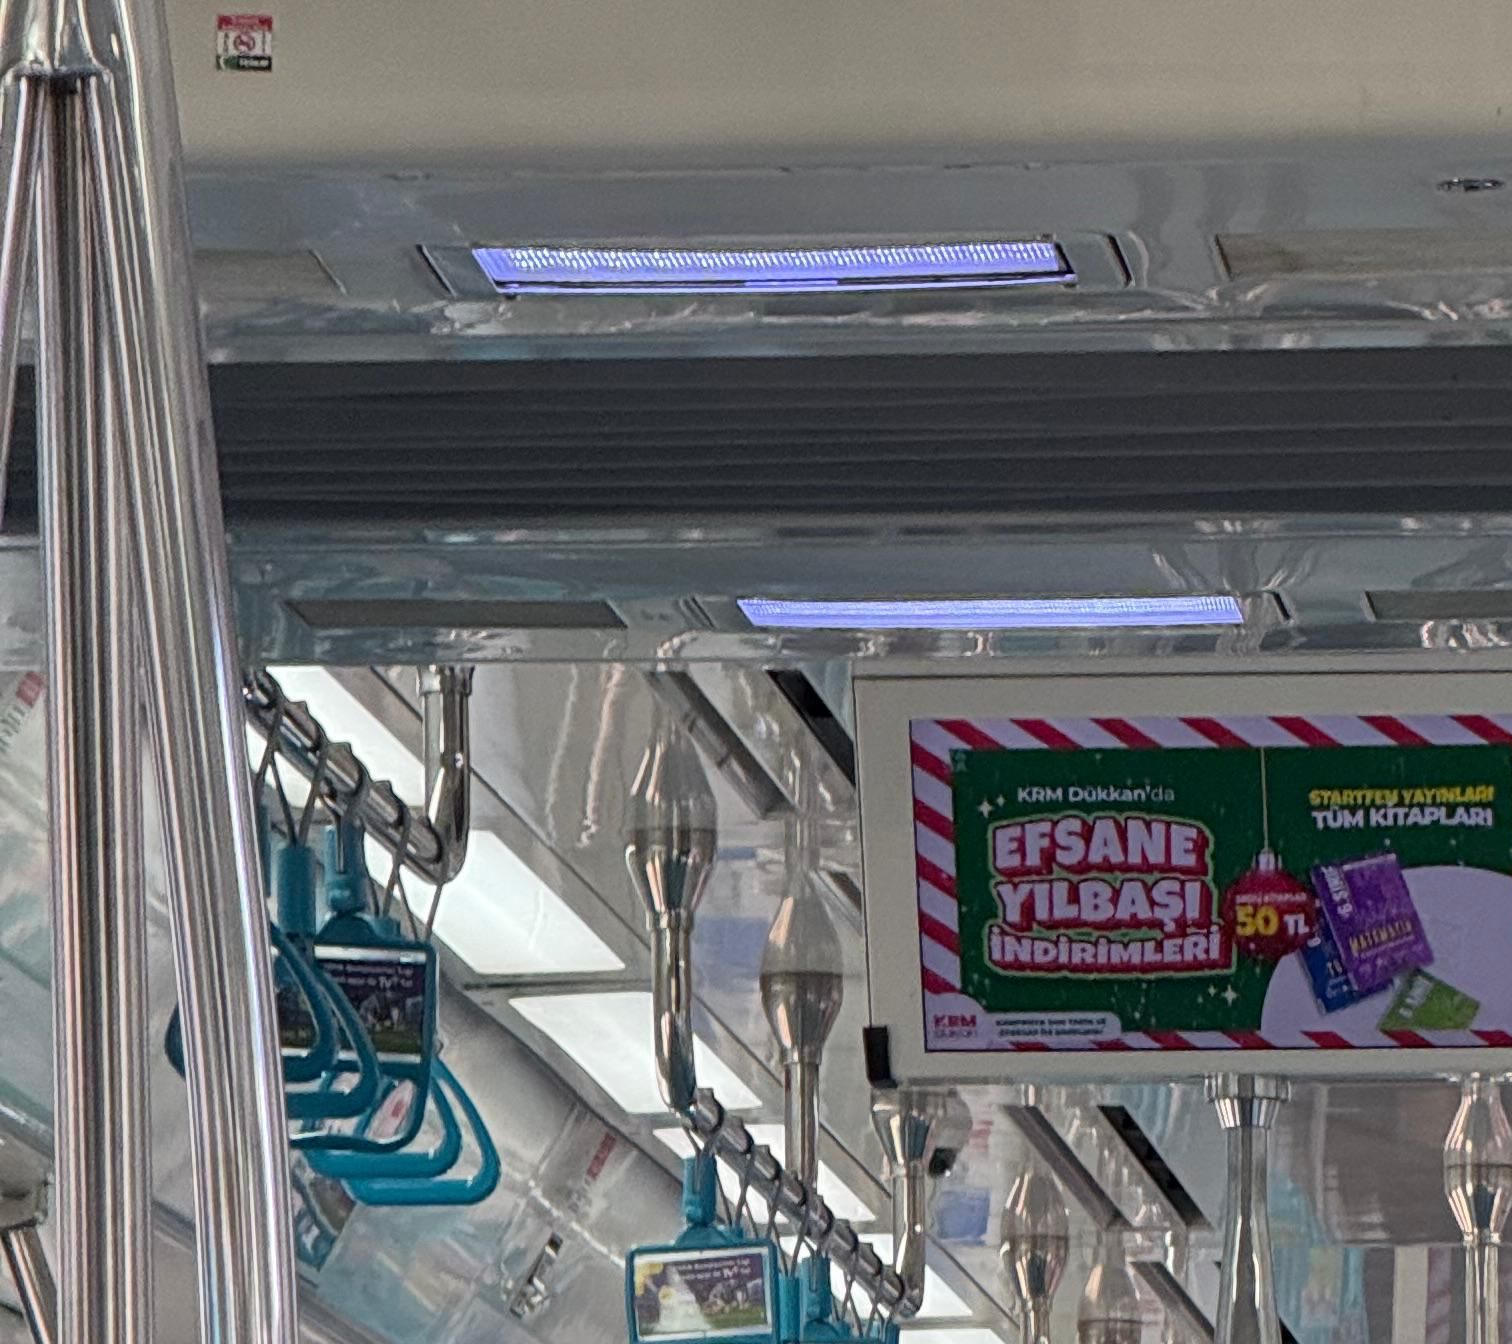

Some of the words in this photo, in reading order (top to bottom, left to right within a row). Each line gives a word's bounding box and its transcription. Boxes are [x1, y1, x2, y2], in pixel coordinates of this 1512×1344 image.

[1017, 786, 1063, 803] KRM
[1068, 784, 1175, 803] Dükkan'da
[1312, 807, 1365, 829] TÜM
[1369, 804, 1494, 828] KİTAPLARI
[994, 817, 1201, 870] EFSANE
[997, 879, 1204, 930] YILBAŞI
[1235, 904, 1279, 936] 50
[1283, 912, 1310, 936] TL
[989, 924, 1221, 964] İNDİRİMLERİ
